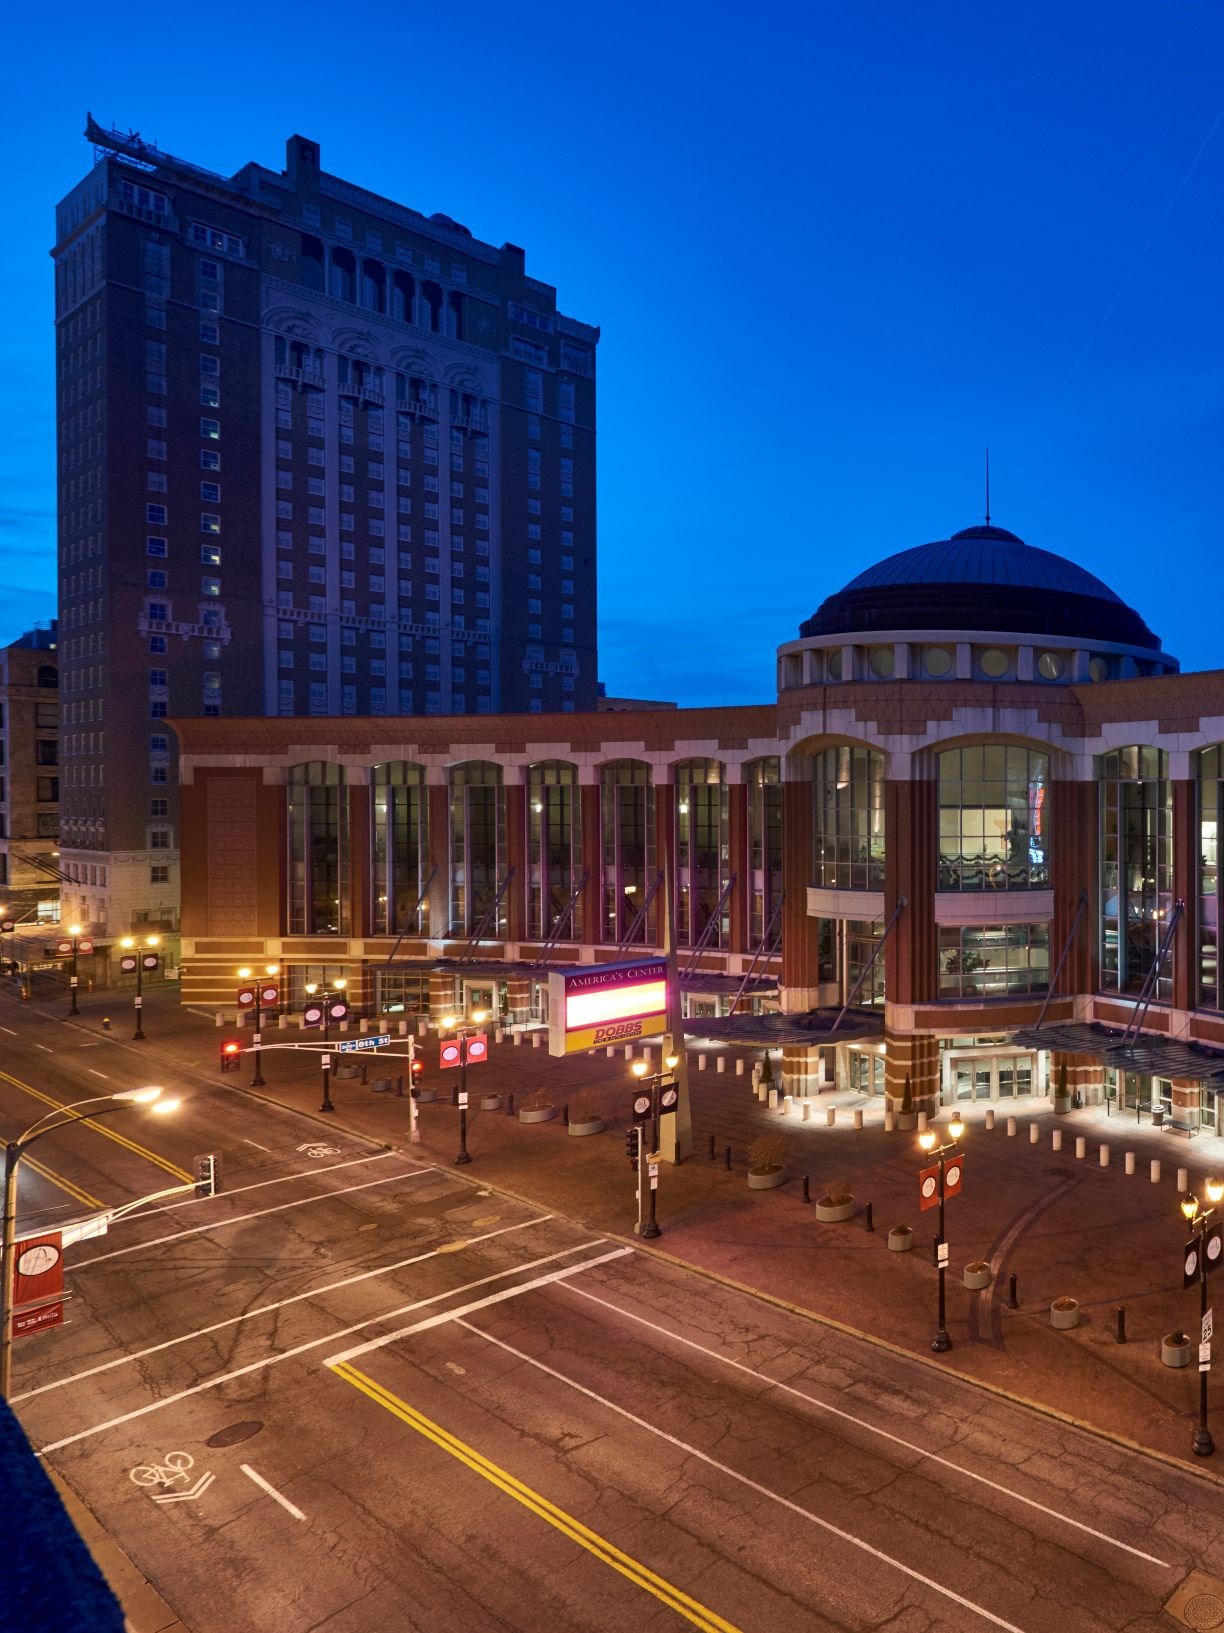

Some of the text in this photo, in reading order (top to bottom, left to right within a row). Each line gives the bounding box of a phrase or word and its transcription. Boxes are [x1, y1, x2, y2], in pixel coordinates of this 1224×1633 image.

[569, 966, 664, 988] AMERICA'S CENTER
[594, 1021, 642, 1040] DOBBS
[358, 1039, 375, 1048] 8th
[378, 1037, 388, 1045] St
[1203, 1323, 1211, 1341] 25
